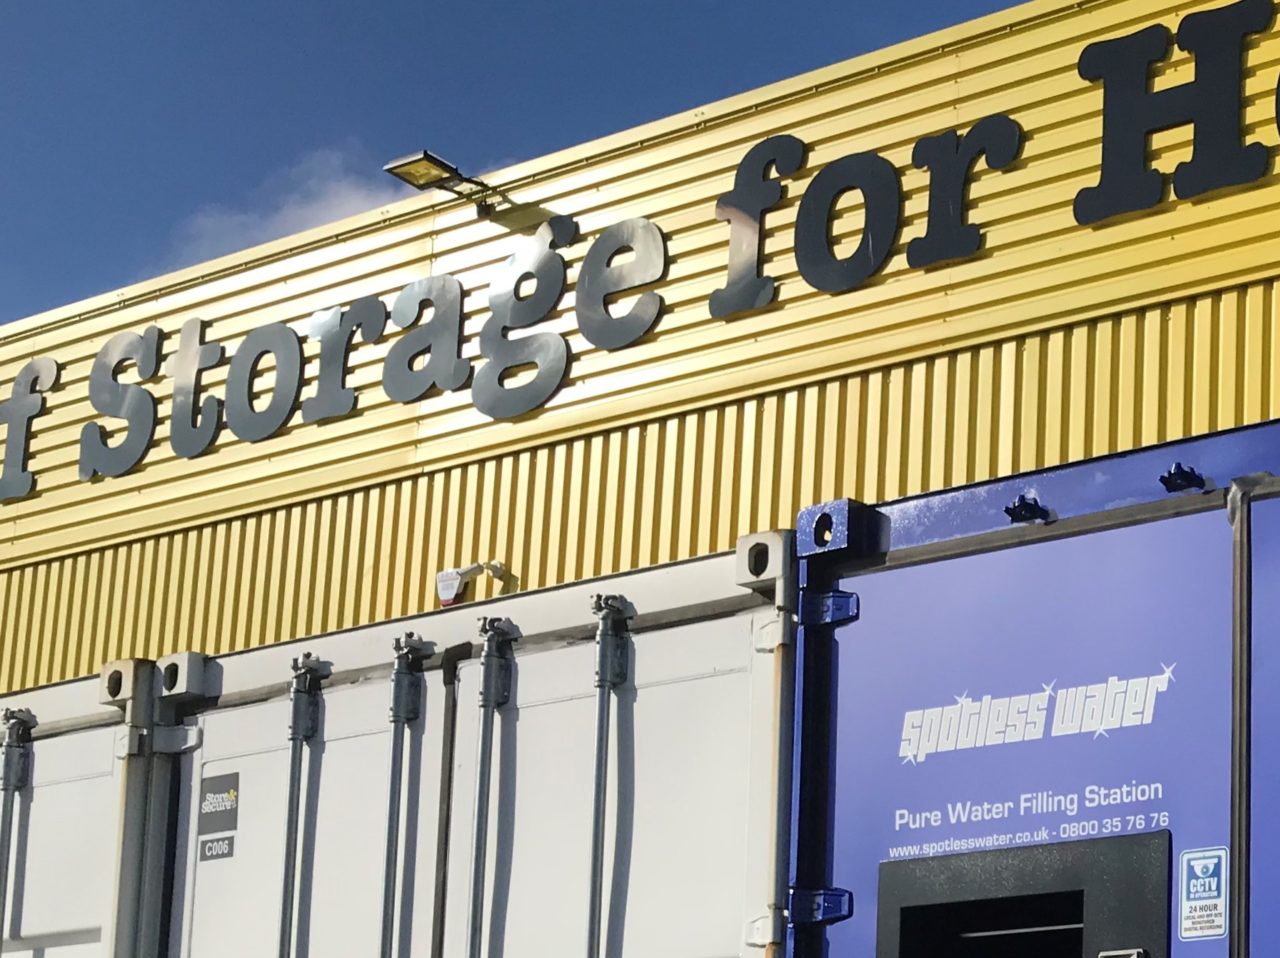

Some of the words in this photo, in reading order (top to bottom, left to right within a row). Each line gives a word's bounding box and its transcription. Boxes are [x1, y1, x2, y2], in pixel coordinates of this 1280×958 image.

[79, 215, 666, 482] Storage
[707, 134, 1024, 321] for
[899, 692, 1049, 762] spotless
[1051, 674, 1169, 737] water
[895, 809, 942, 831] Pure
[947, 801, 1015, 825] Water
[1019, 790, 1079, 816] Filling
[1084, 781, 1163, 808] Station
[205, 840, 228, 856] C006
[889, 827, 1049, 858] www.spotlesswater.co.uk
[1060, 821, 1098, 838] 0800
[1102, 818, 1121, 832] 35
[1125, 814, 1146, 830] 76
[1149, 811, 1169, 826] 76
[1189, 877, 1218, 893] CCTV
[1189, 906, 1198, 914] 24
[1198, 903, 1218, 913] HOUR
